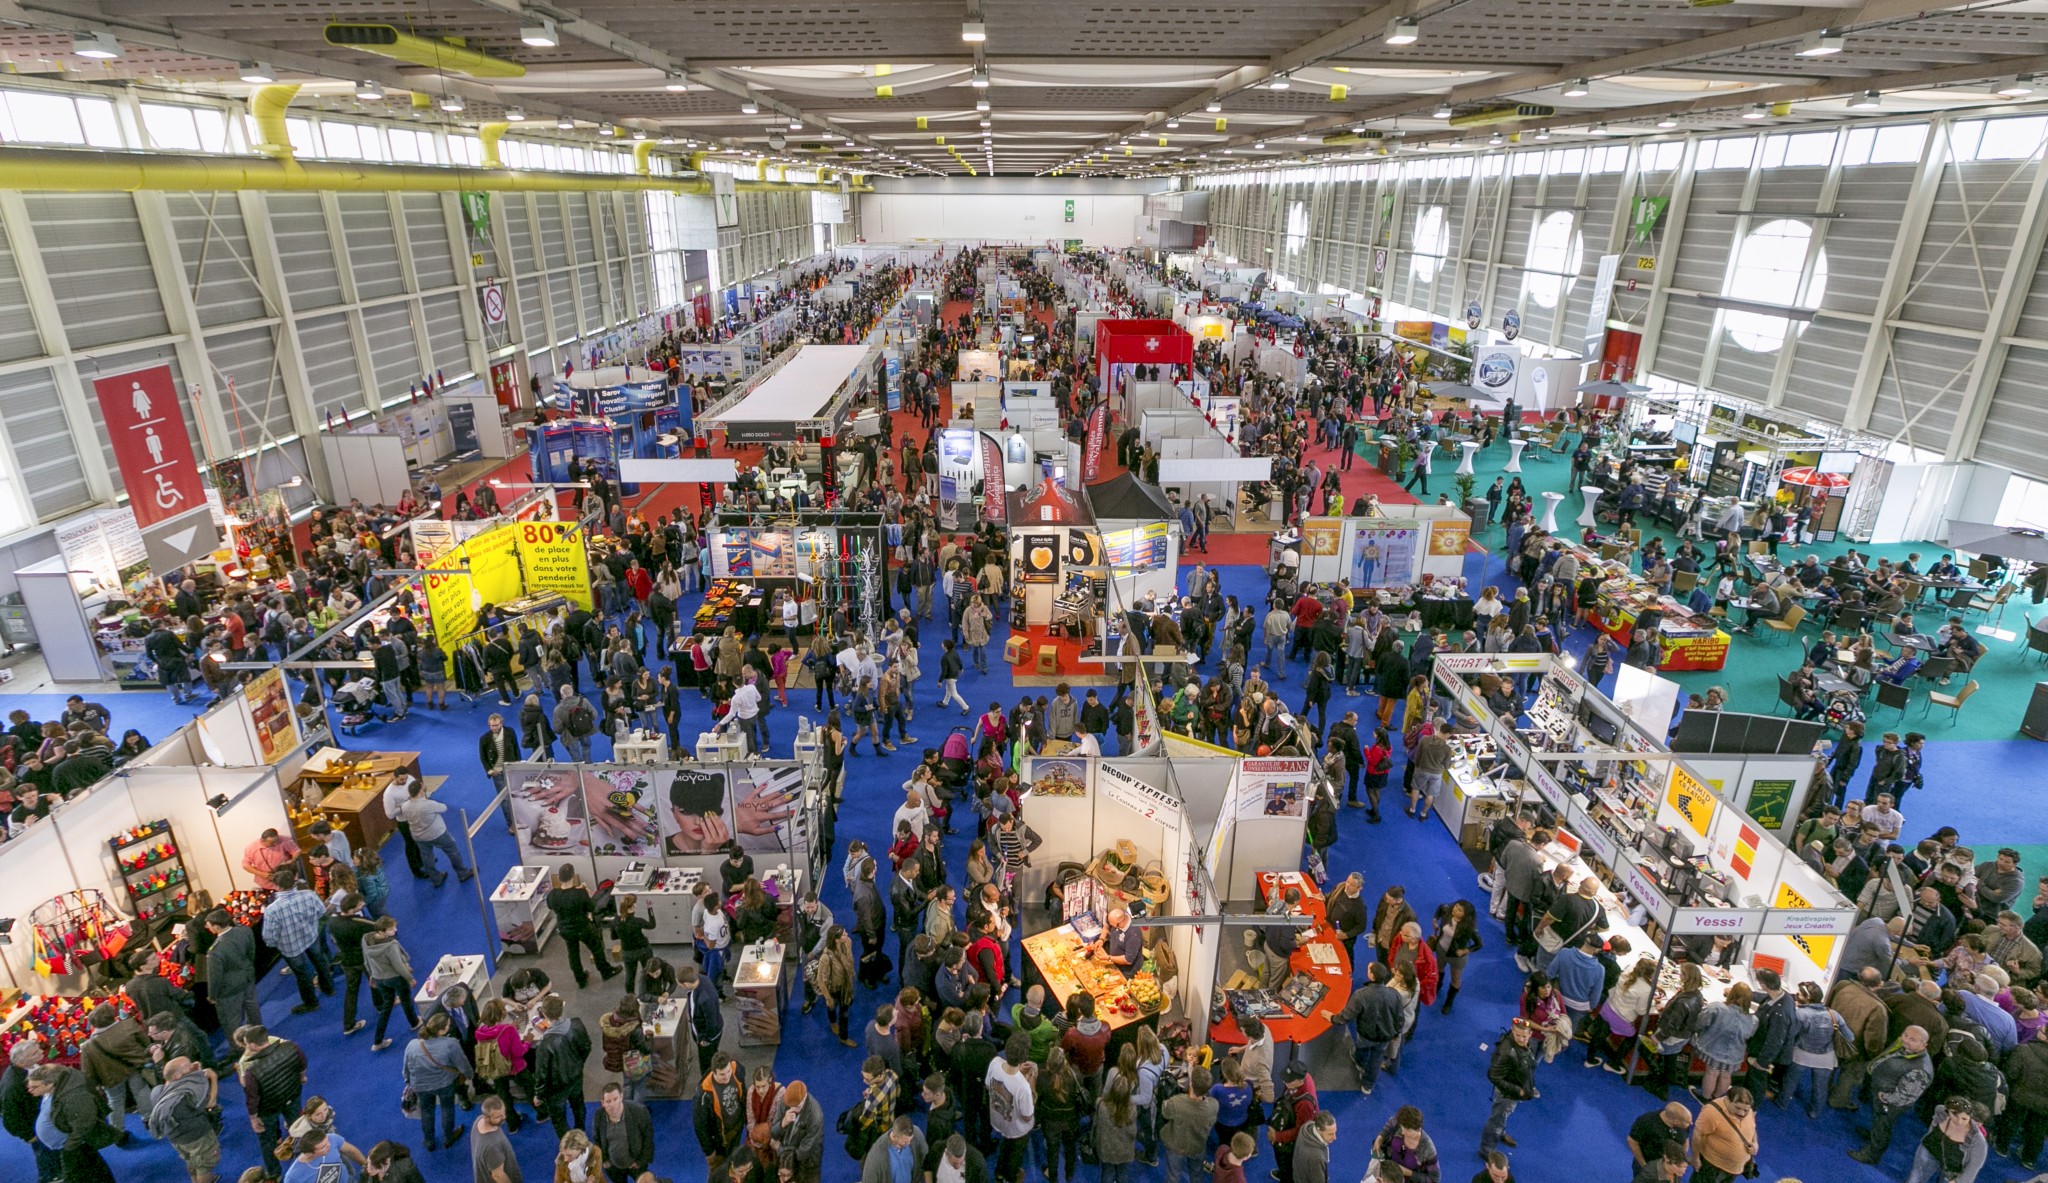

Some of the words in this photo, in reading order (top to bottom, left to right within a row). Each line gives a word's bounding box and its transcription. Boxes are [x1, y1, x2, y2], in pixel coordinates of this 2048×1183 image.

[1638, 258, 1654, 268] 725
[638, 391, 665, 399] Novgorod
[645, 399, 664, 407] region
[604, 404, 626, 413] Cluster
[102, 510, 133, 526] NOUVEA
[60, 522, 99, 540] NOUVEAU
[524, 524, 577, 544] 80%
[548, 546, 570, 554] place
[1284, 762, 1288, 771] 2
[1289, 762, 1308, 771] ANS
[674, 775, 710, 784] MOYOU
[1537, 772, 1560, 801] Yesss!
[1678, 770, 1711, 802] PYRAMID
[1679, 780, 1705, 807] CREATOR
[738, 803, 773, 812] MOYOU
[1116, 796, 1138, 811] Couteau
[1145, 809, 1155, 818] 2
[1155, 817, 1177, 832] vitesses
[1629, 871, 1660, 910] Yesss!
[1695, 916, 1743, 927] Yesss!
[1786, 915, 1836, 923] Kreativspiele
